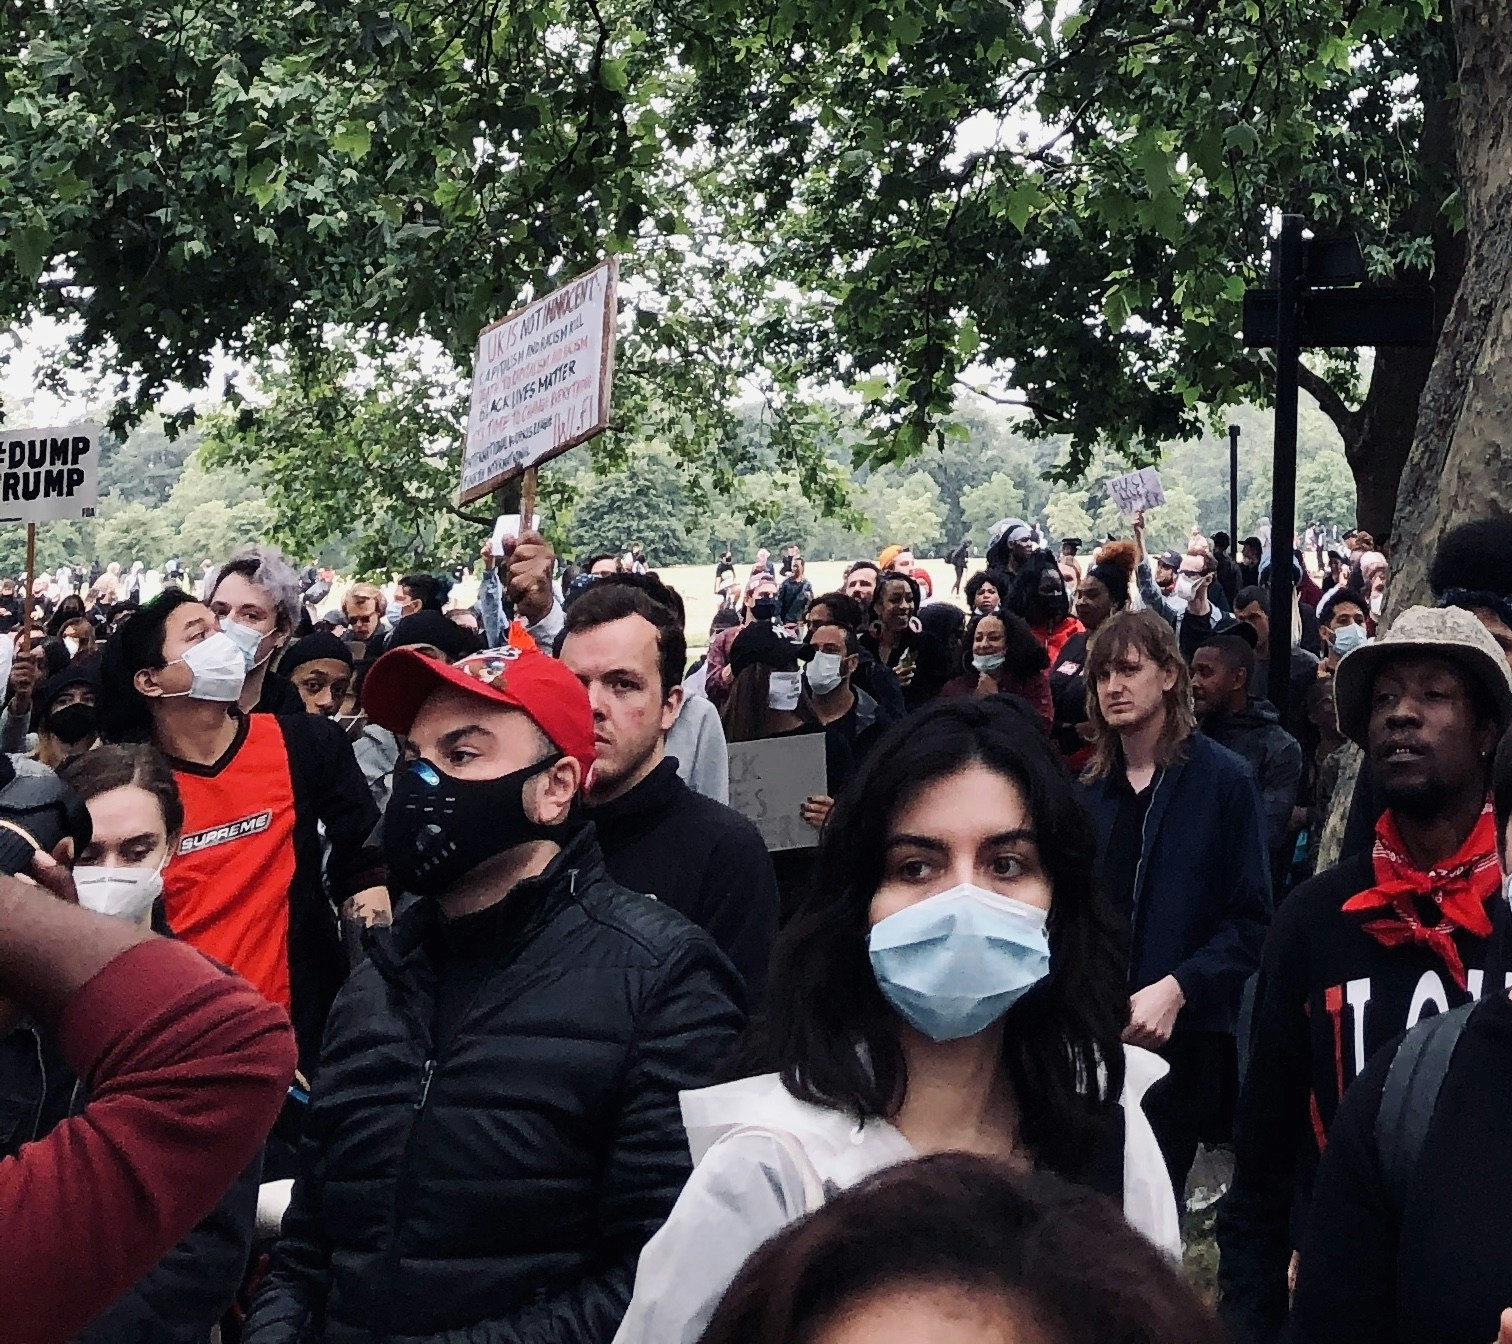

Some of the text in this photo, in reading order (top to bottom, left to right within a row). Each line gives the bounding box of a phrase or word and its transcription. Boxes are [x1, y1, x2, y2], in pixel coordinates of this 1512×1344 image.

[488, 333, 504, 362] UK
[507, 322, 517, 350] IS
[520, 307, 543, 339] NOT
[478, 356, 576, 424] BLACK LIVES MATTER
[0, 468, 84, 502] RUMP
[182, 814, 267, 850] SUPREME
